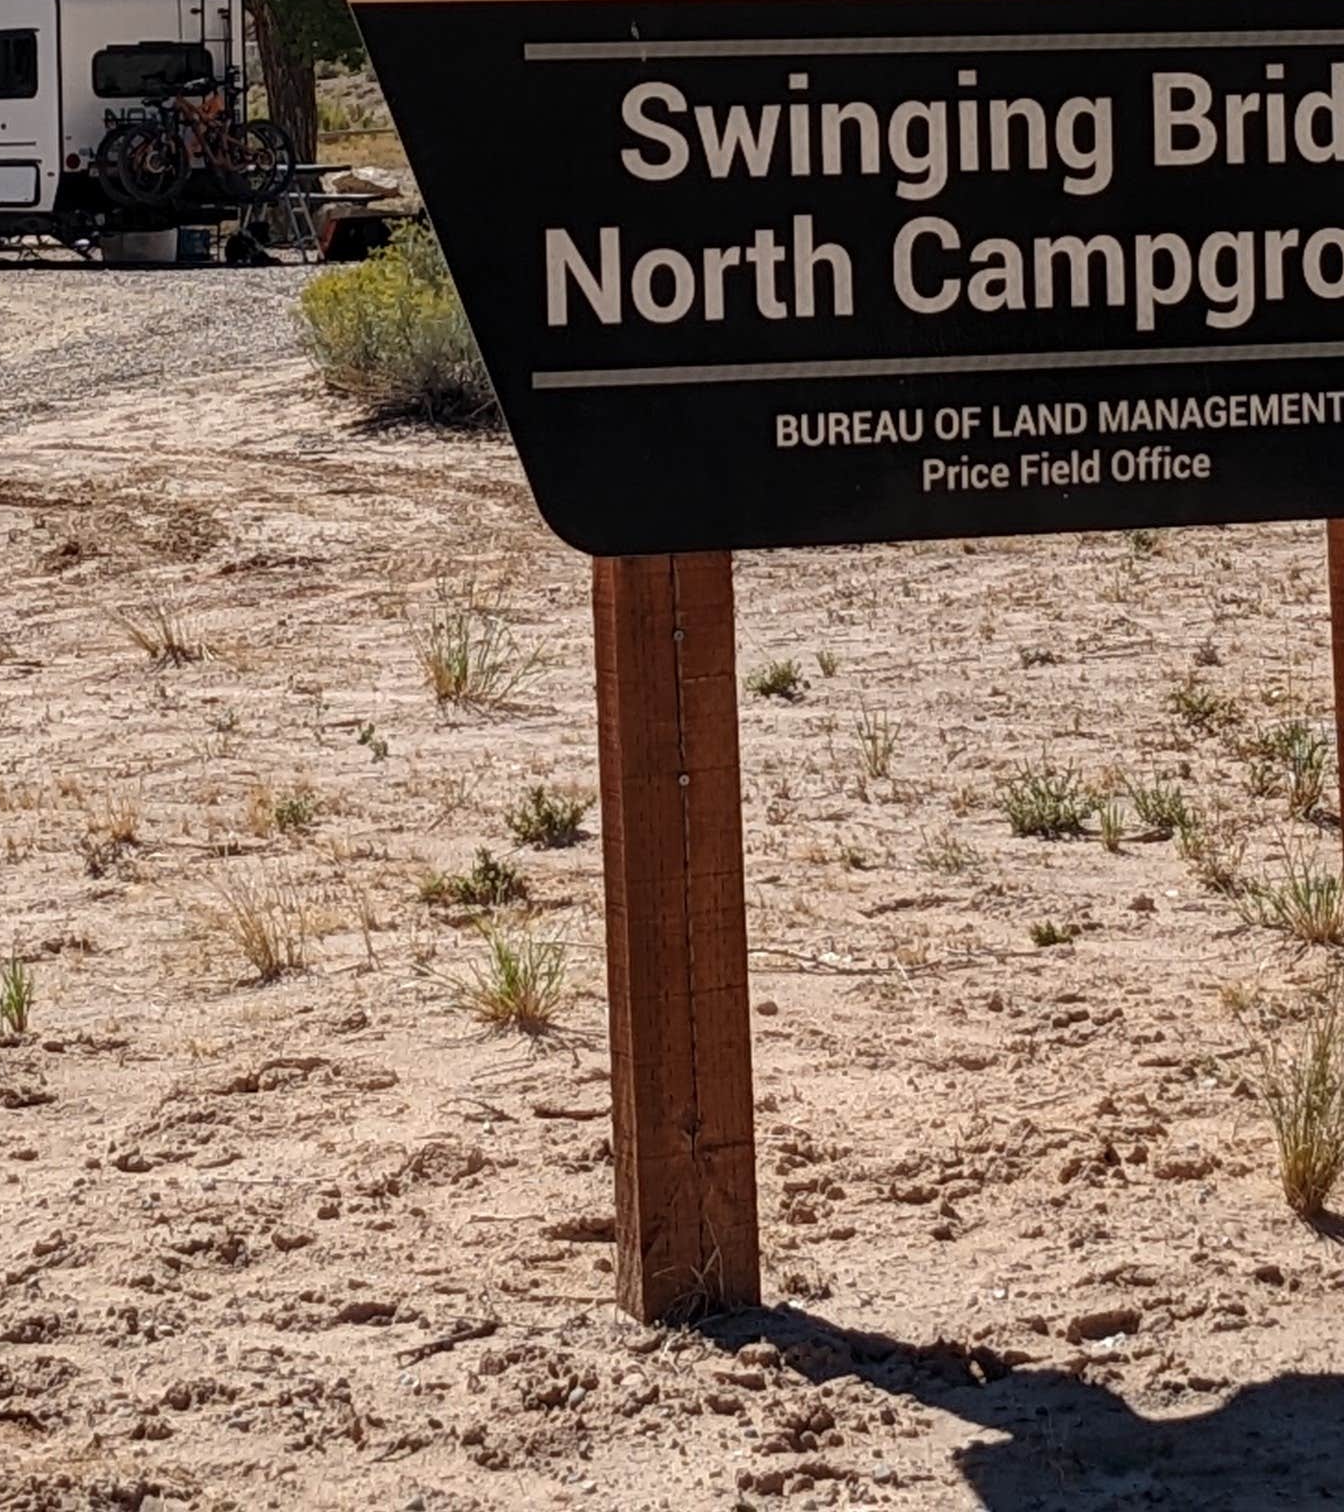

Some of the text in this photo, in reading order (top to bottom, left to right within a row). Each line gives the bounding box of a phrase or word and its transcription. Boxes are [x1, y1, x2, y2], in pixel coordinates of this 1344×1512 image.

[620, 70, 1113, 201] Swinging
[545, 213, 854, 326] North
[776, 408, 924, 448] BUREAU
[934, 406, 982, 441] OF
[992, 402, 1089, 439] LAND
[922, 445, 1211, 492] Price Field Office
